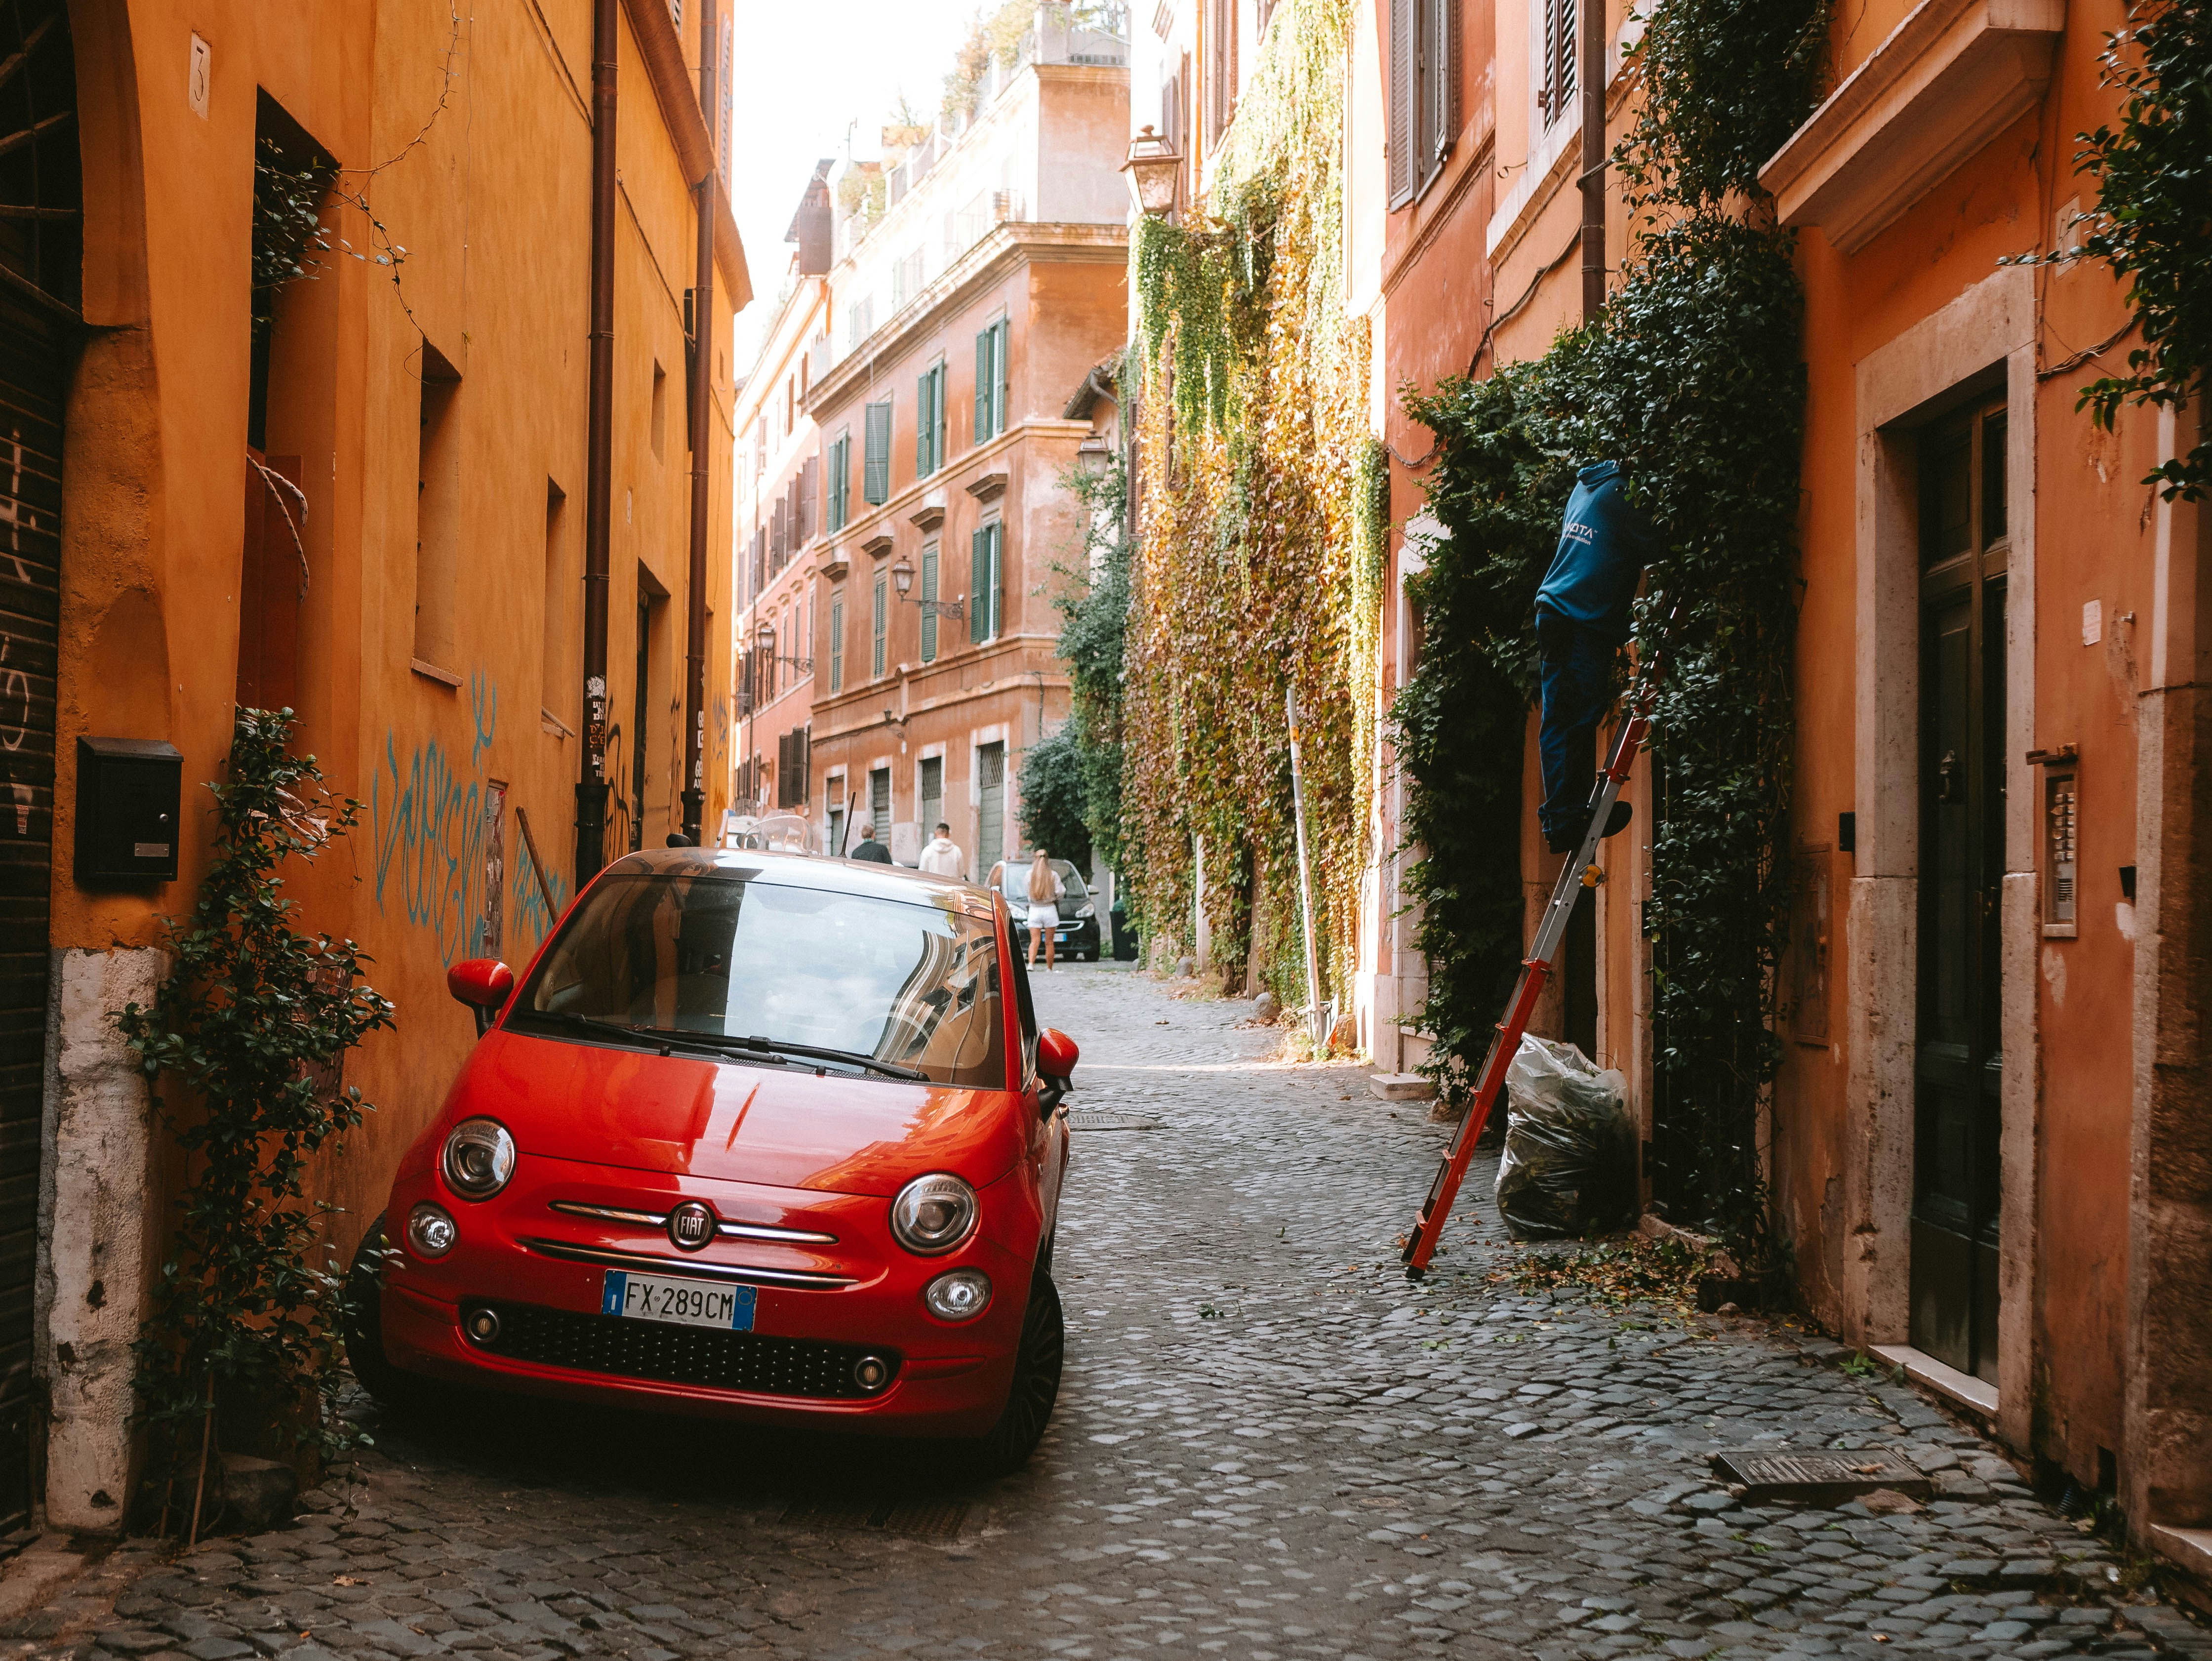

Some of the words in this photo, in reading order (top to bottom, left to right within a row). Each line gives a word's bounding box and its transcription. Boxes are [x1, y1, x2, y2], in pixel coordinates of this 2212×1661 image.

[194, 45, 204, 102] 3
[680, 1216, 704, 1236] FIAT
[625, 1282, 654, 1312] FX
[660, 1287, 734, 1321] 289CM
